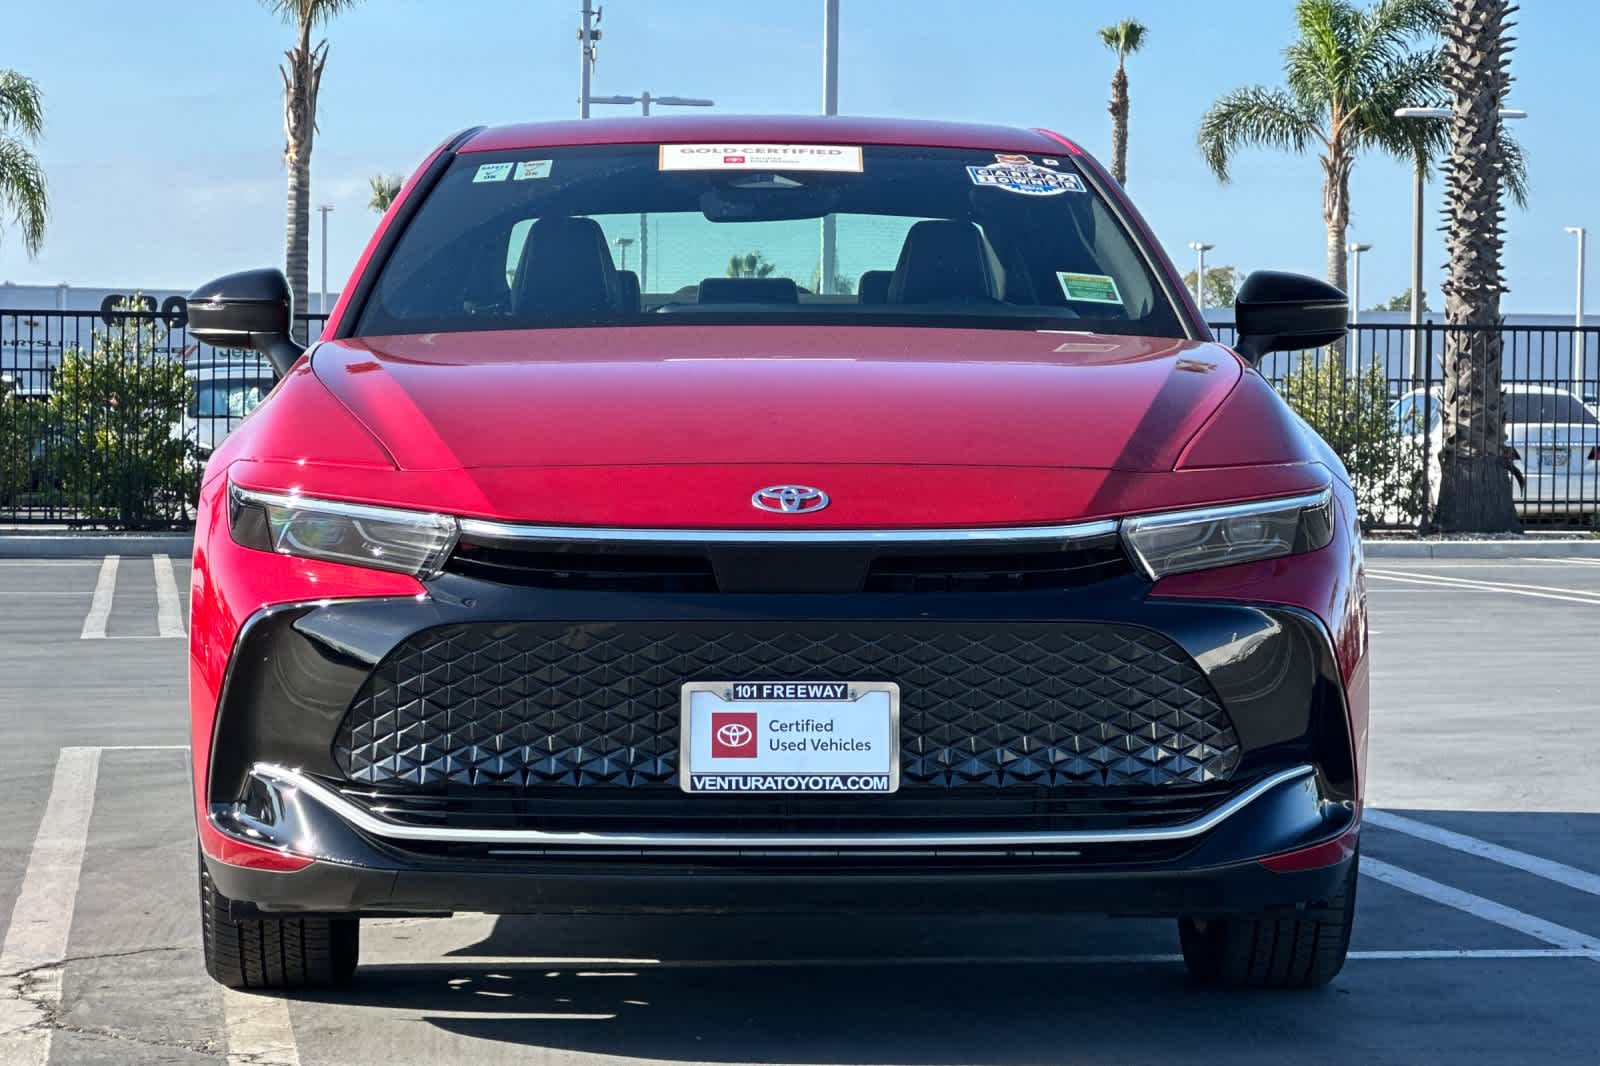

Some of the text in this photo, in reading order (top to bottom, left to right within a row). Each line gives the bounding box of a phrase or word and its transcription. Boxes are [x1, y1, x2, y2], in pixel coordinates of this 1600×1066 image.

[736, 685, 845, 698] 101 FREEWAY
[769, 719, 834, 732] Certified
[769, 738, 871, 751] Used Vehicles
[692, 776, 888, 790] VENTURATOYOTA.COM
